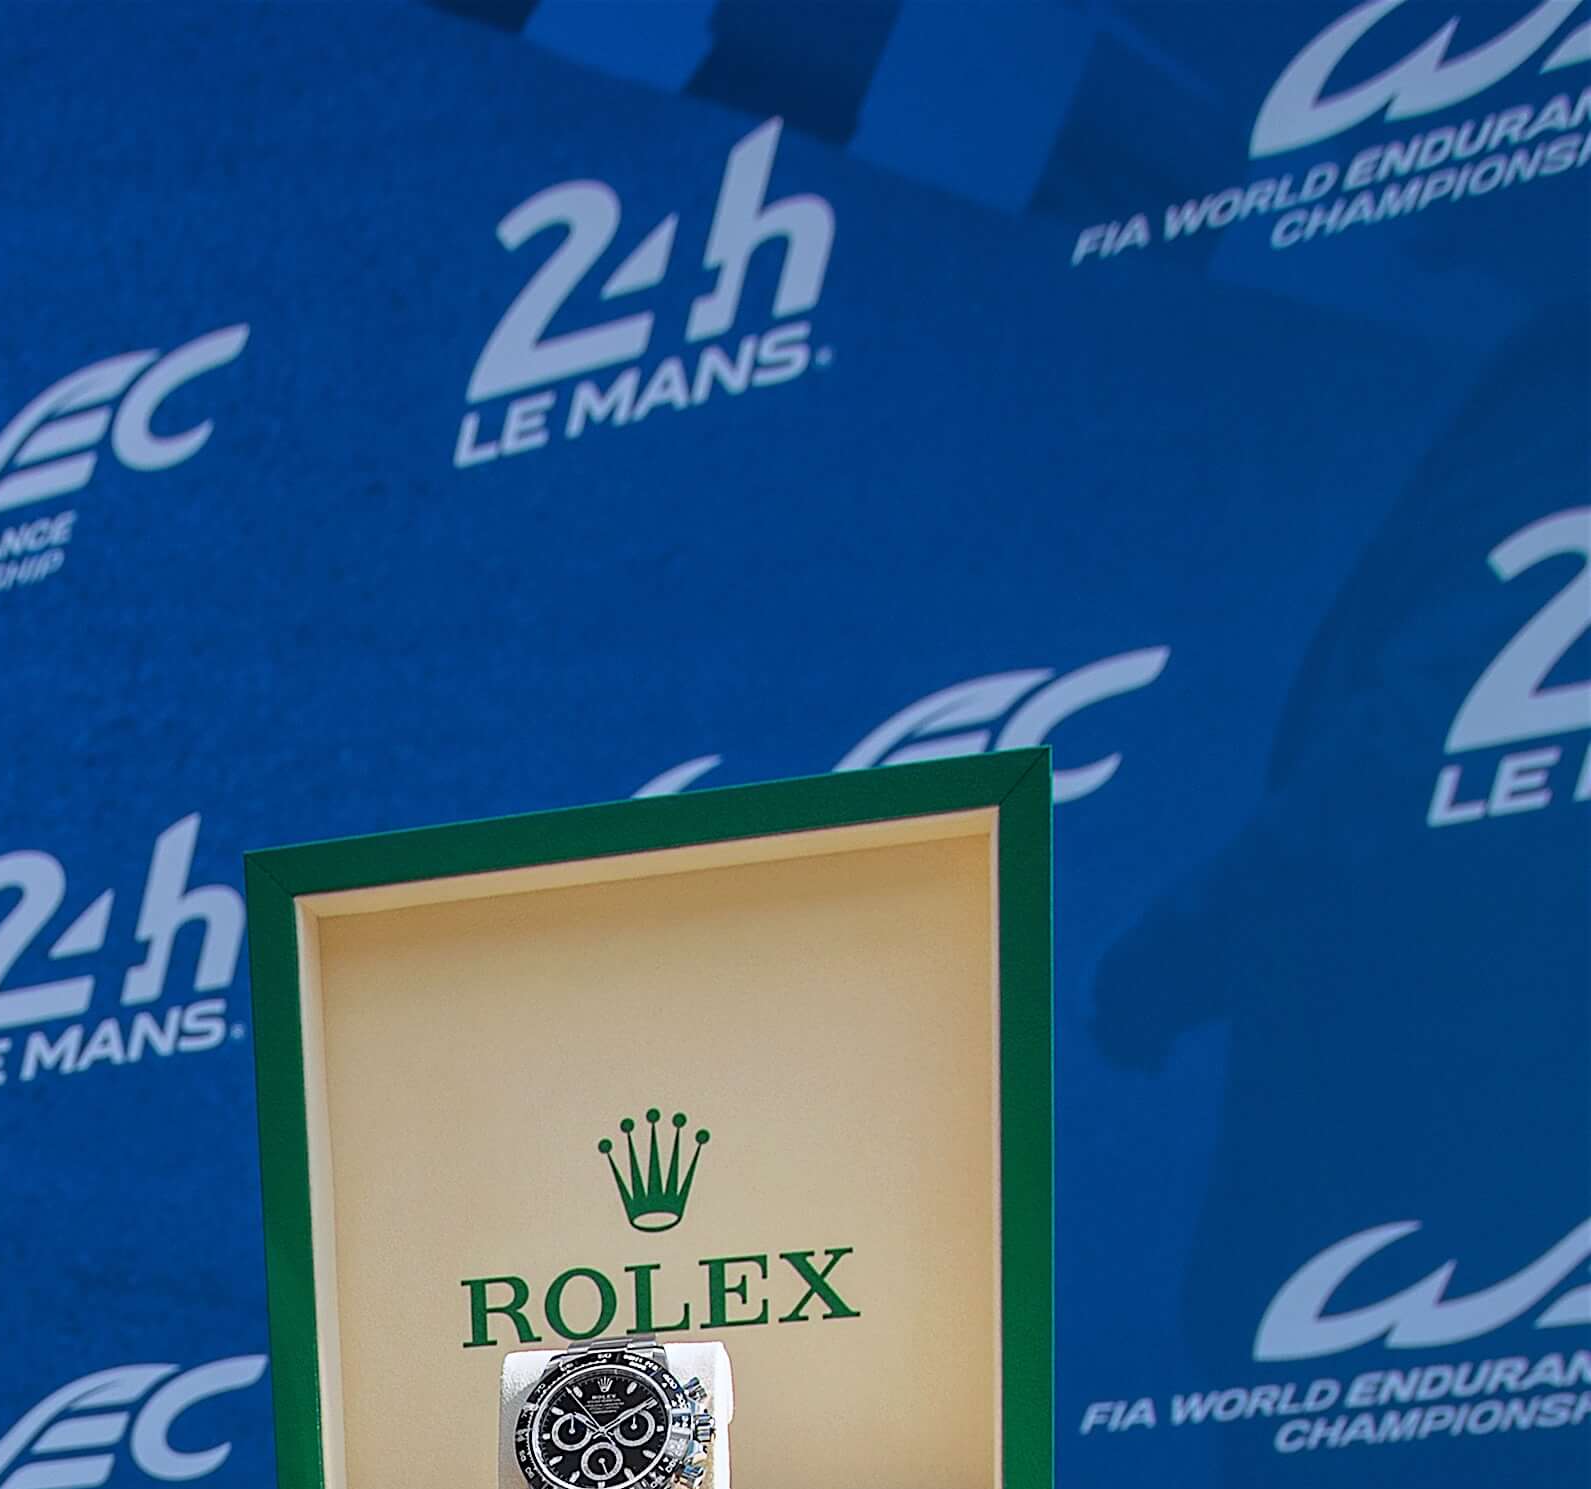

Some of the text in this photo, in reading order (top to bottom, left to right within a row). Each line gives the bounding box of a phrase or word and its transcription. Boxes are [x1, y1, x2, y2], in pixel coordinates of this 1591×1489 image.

[466, 115, 836, 403] 24h
[1070, 212, 1150, 268] FIA
[1164, 161, 1340, 242] WORLD
[453, 390, 556, 469] LE
[1425, 744, 1564, 828] LE
[461, 1247, 862, 1349] ROLEX
[1079, 1397, 1156, 1436] FIA
[1171, 1377, 1343, 1428] WORLD
